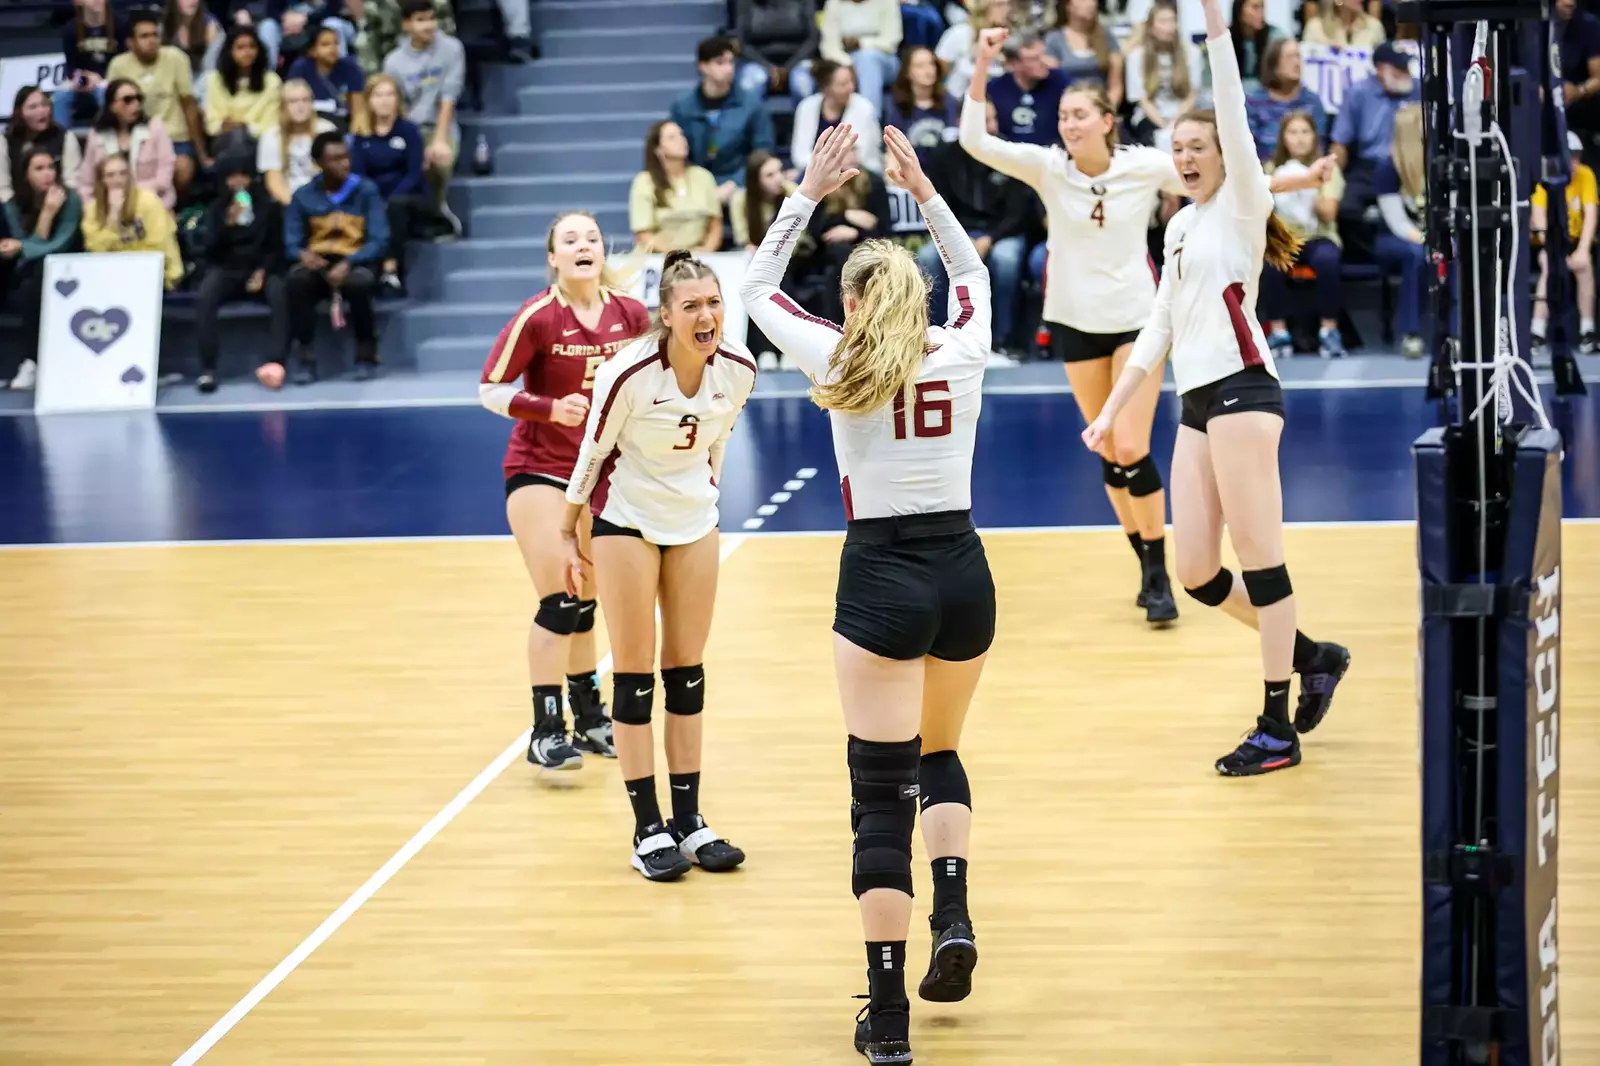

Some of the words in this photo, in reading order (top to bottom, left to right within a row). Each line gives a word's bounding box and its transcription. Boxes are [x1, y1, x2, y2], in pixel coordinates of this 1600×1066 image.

[1090, 199, 1105, 228] 4
[551, 343, 602, 357] FLORIDA
[893, 379, 952, 440] 16
[672, 423, 698, 450] 3
[1535, 565, 1560, 868] TECH
